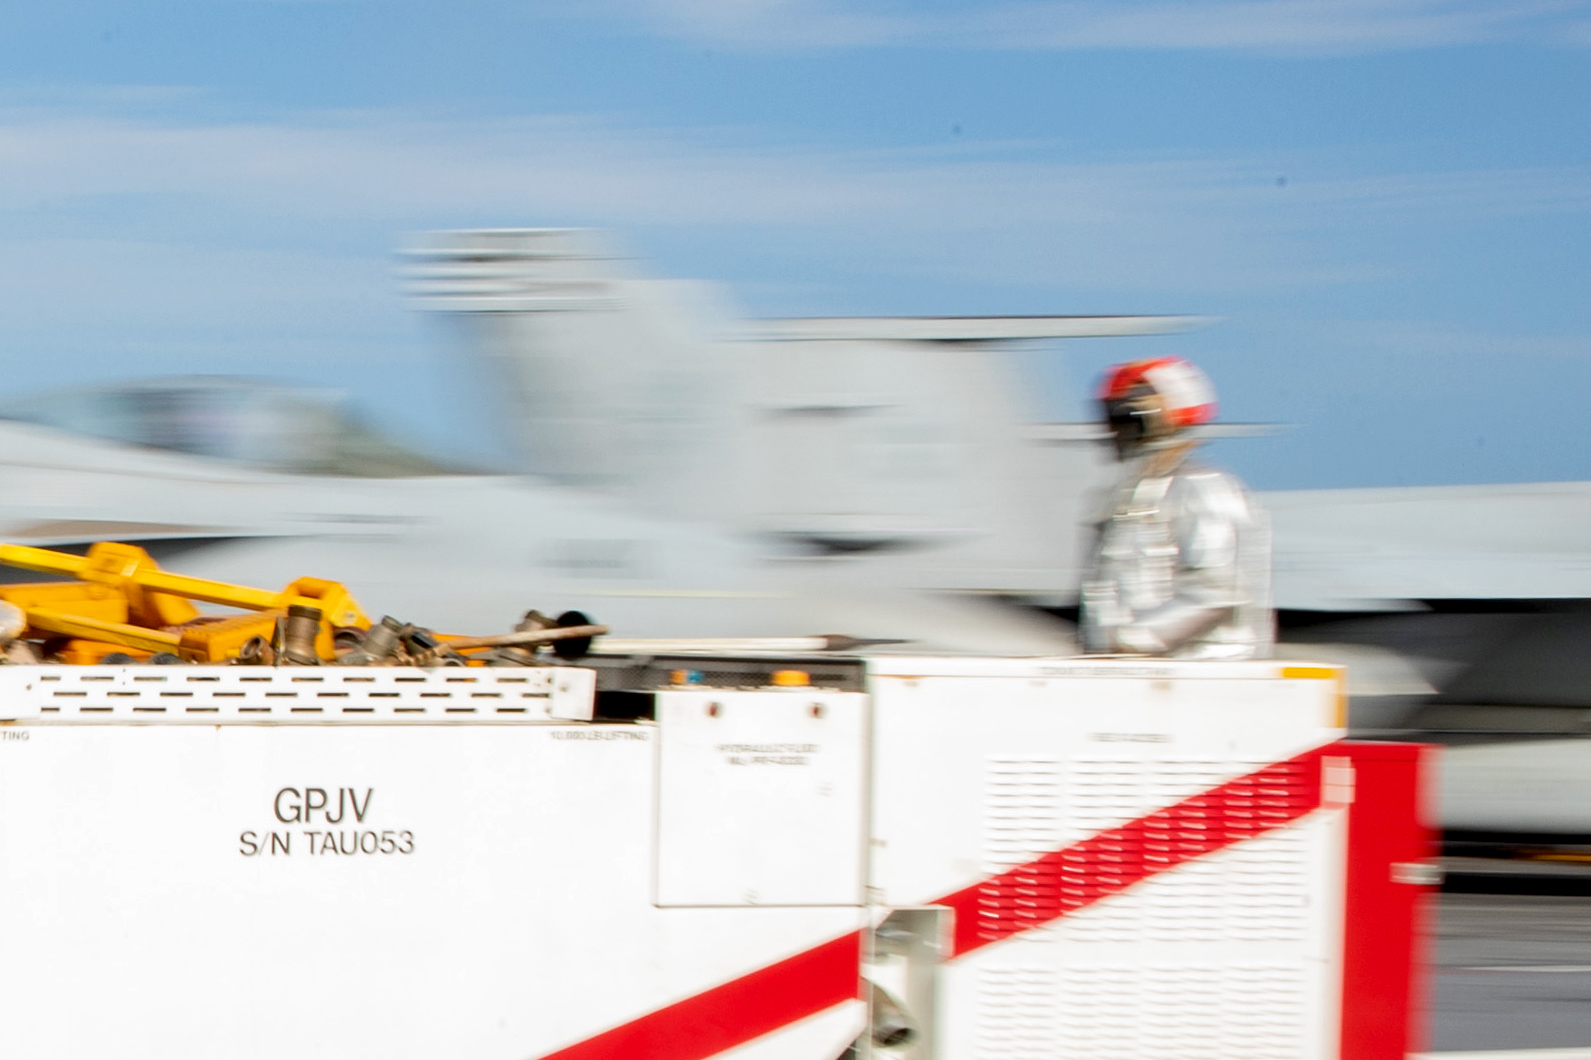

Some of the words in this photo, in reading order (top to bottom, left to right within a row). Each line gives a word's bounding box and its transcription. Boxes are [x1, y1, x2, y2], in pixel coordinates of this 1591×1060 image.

[273, 787, 374, 824] GPJV
[239, 830, 291, 856] S/N
[303, 829, 415, 856] TAU053
